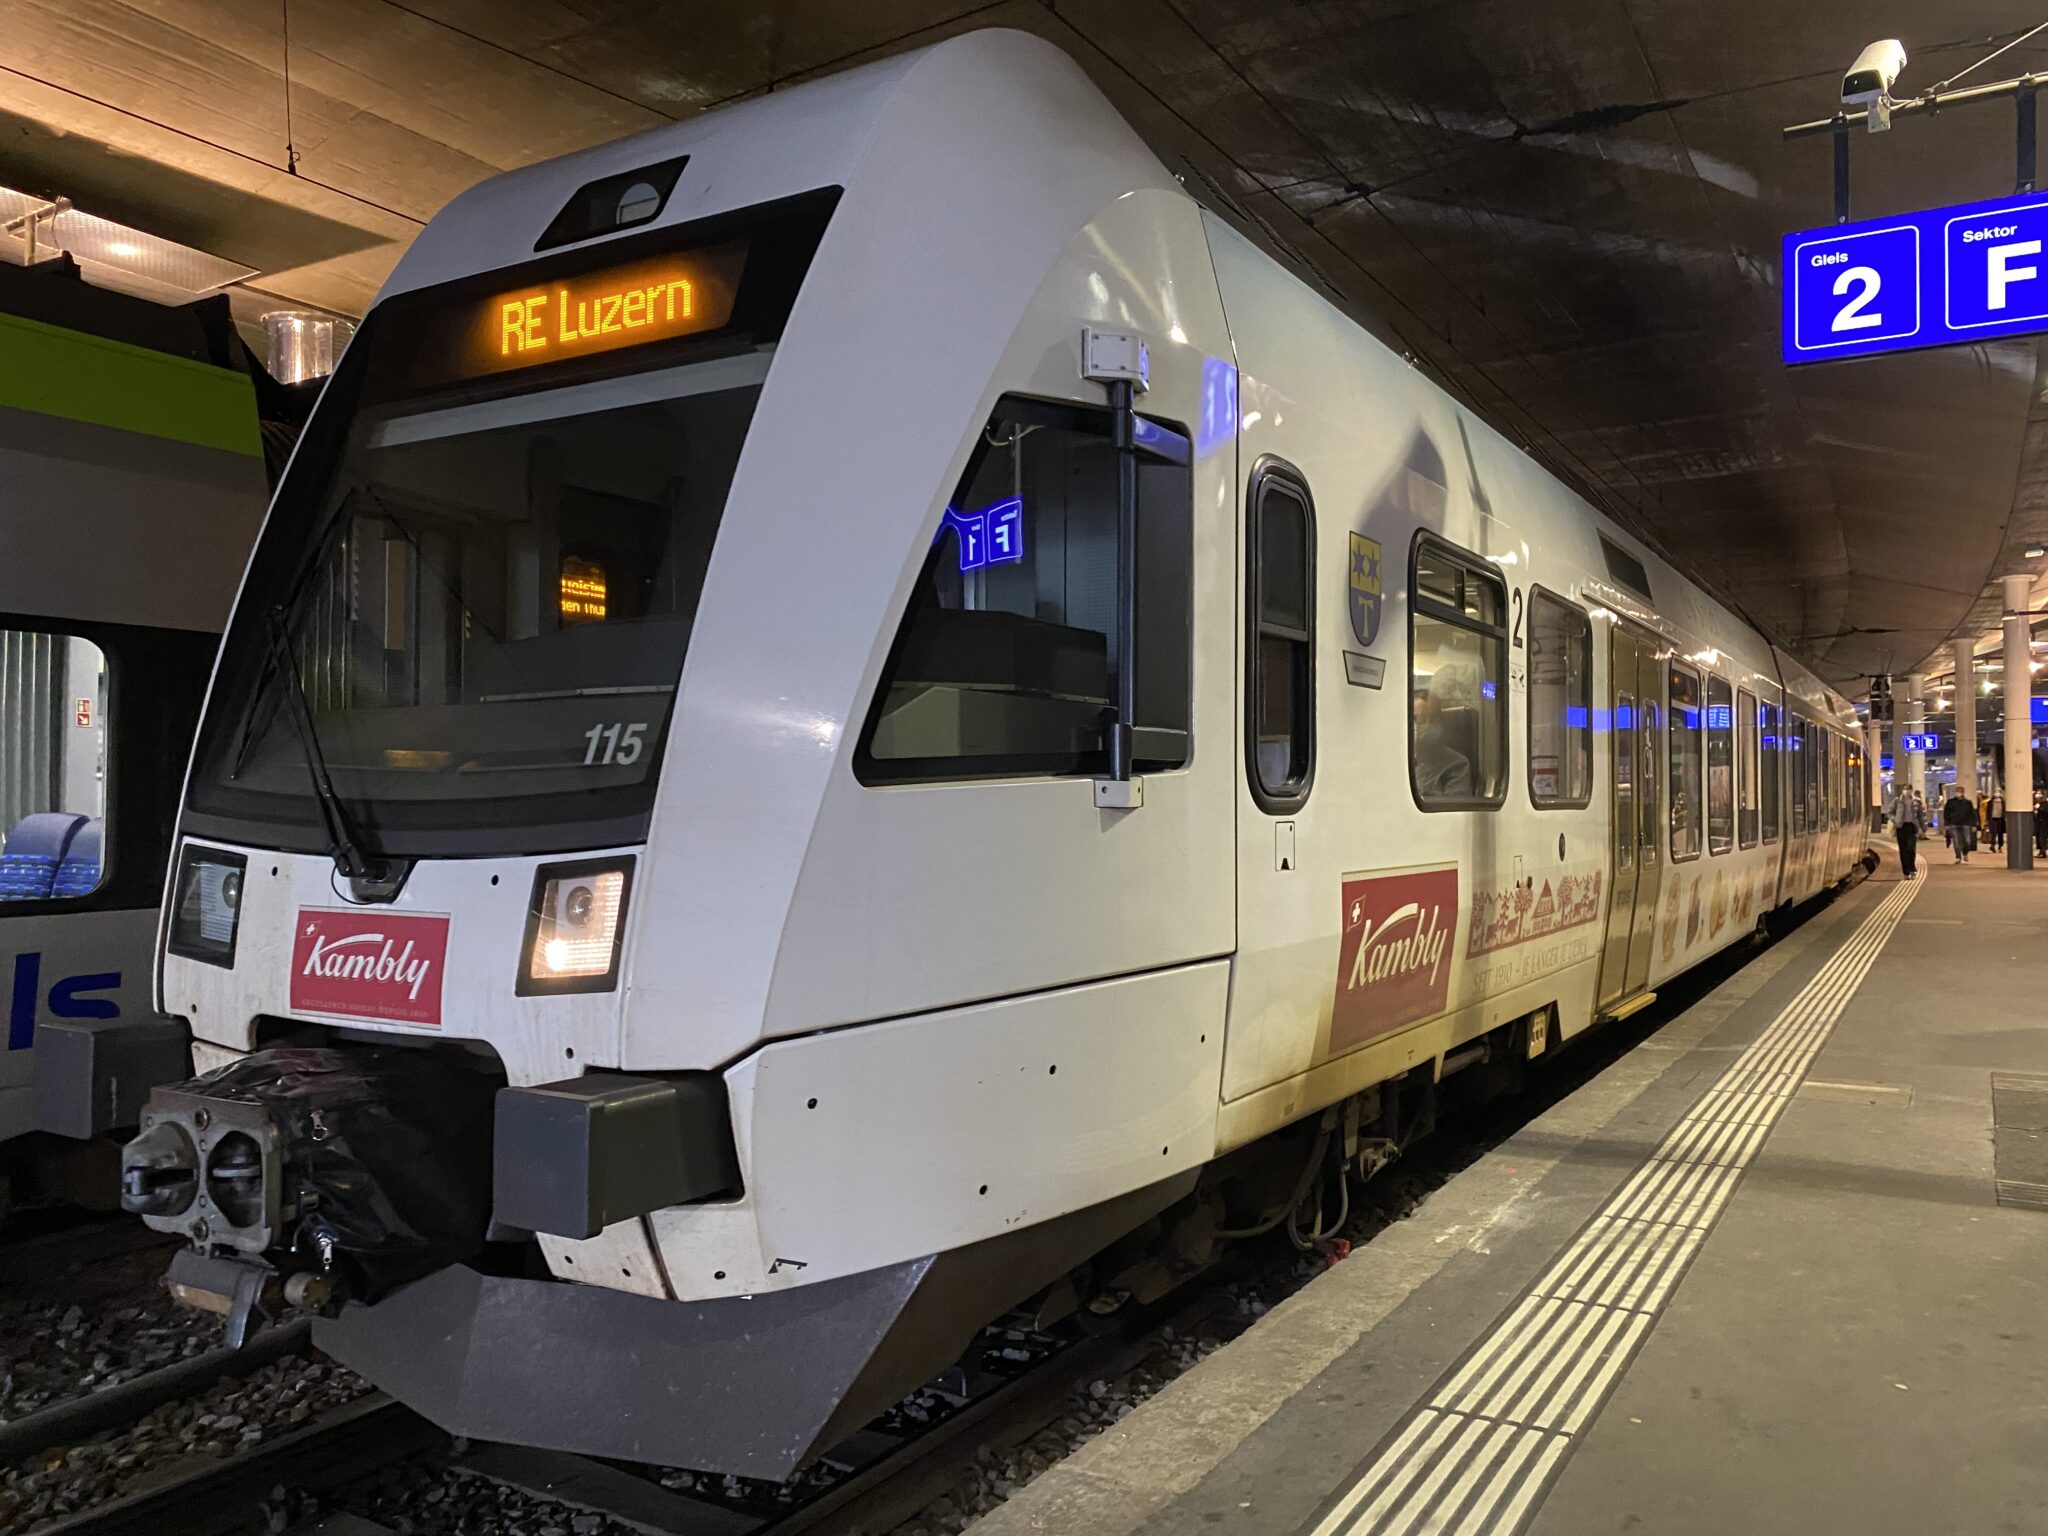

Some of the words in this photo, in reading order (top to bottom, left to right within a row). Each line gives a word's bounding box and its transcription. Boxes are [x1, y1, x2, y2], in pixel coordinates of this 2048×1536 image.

[1811, 252, 1849, 267] Gleis
[1962, 225, 2018, 243] Sektor
[1831, 266, 1882, 332] 2
[1987, 240, 2042, 310] F
[502, 295, 547, 354] RE
[559, 279, 692, 342] Luzern
[1512, 587, 1523, 649] 2
[584, 723, 648, 765] 115
[1908, 739, 1916, 749] 2
[303, 934, 430, 1000] Kambly
[1347, 902, 1448, 990] Kambly
